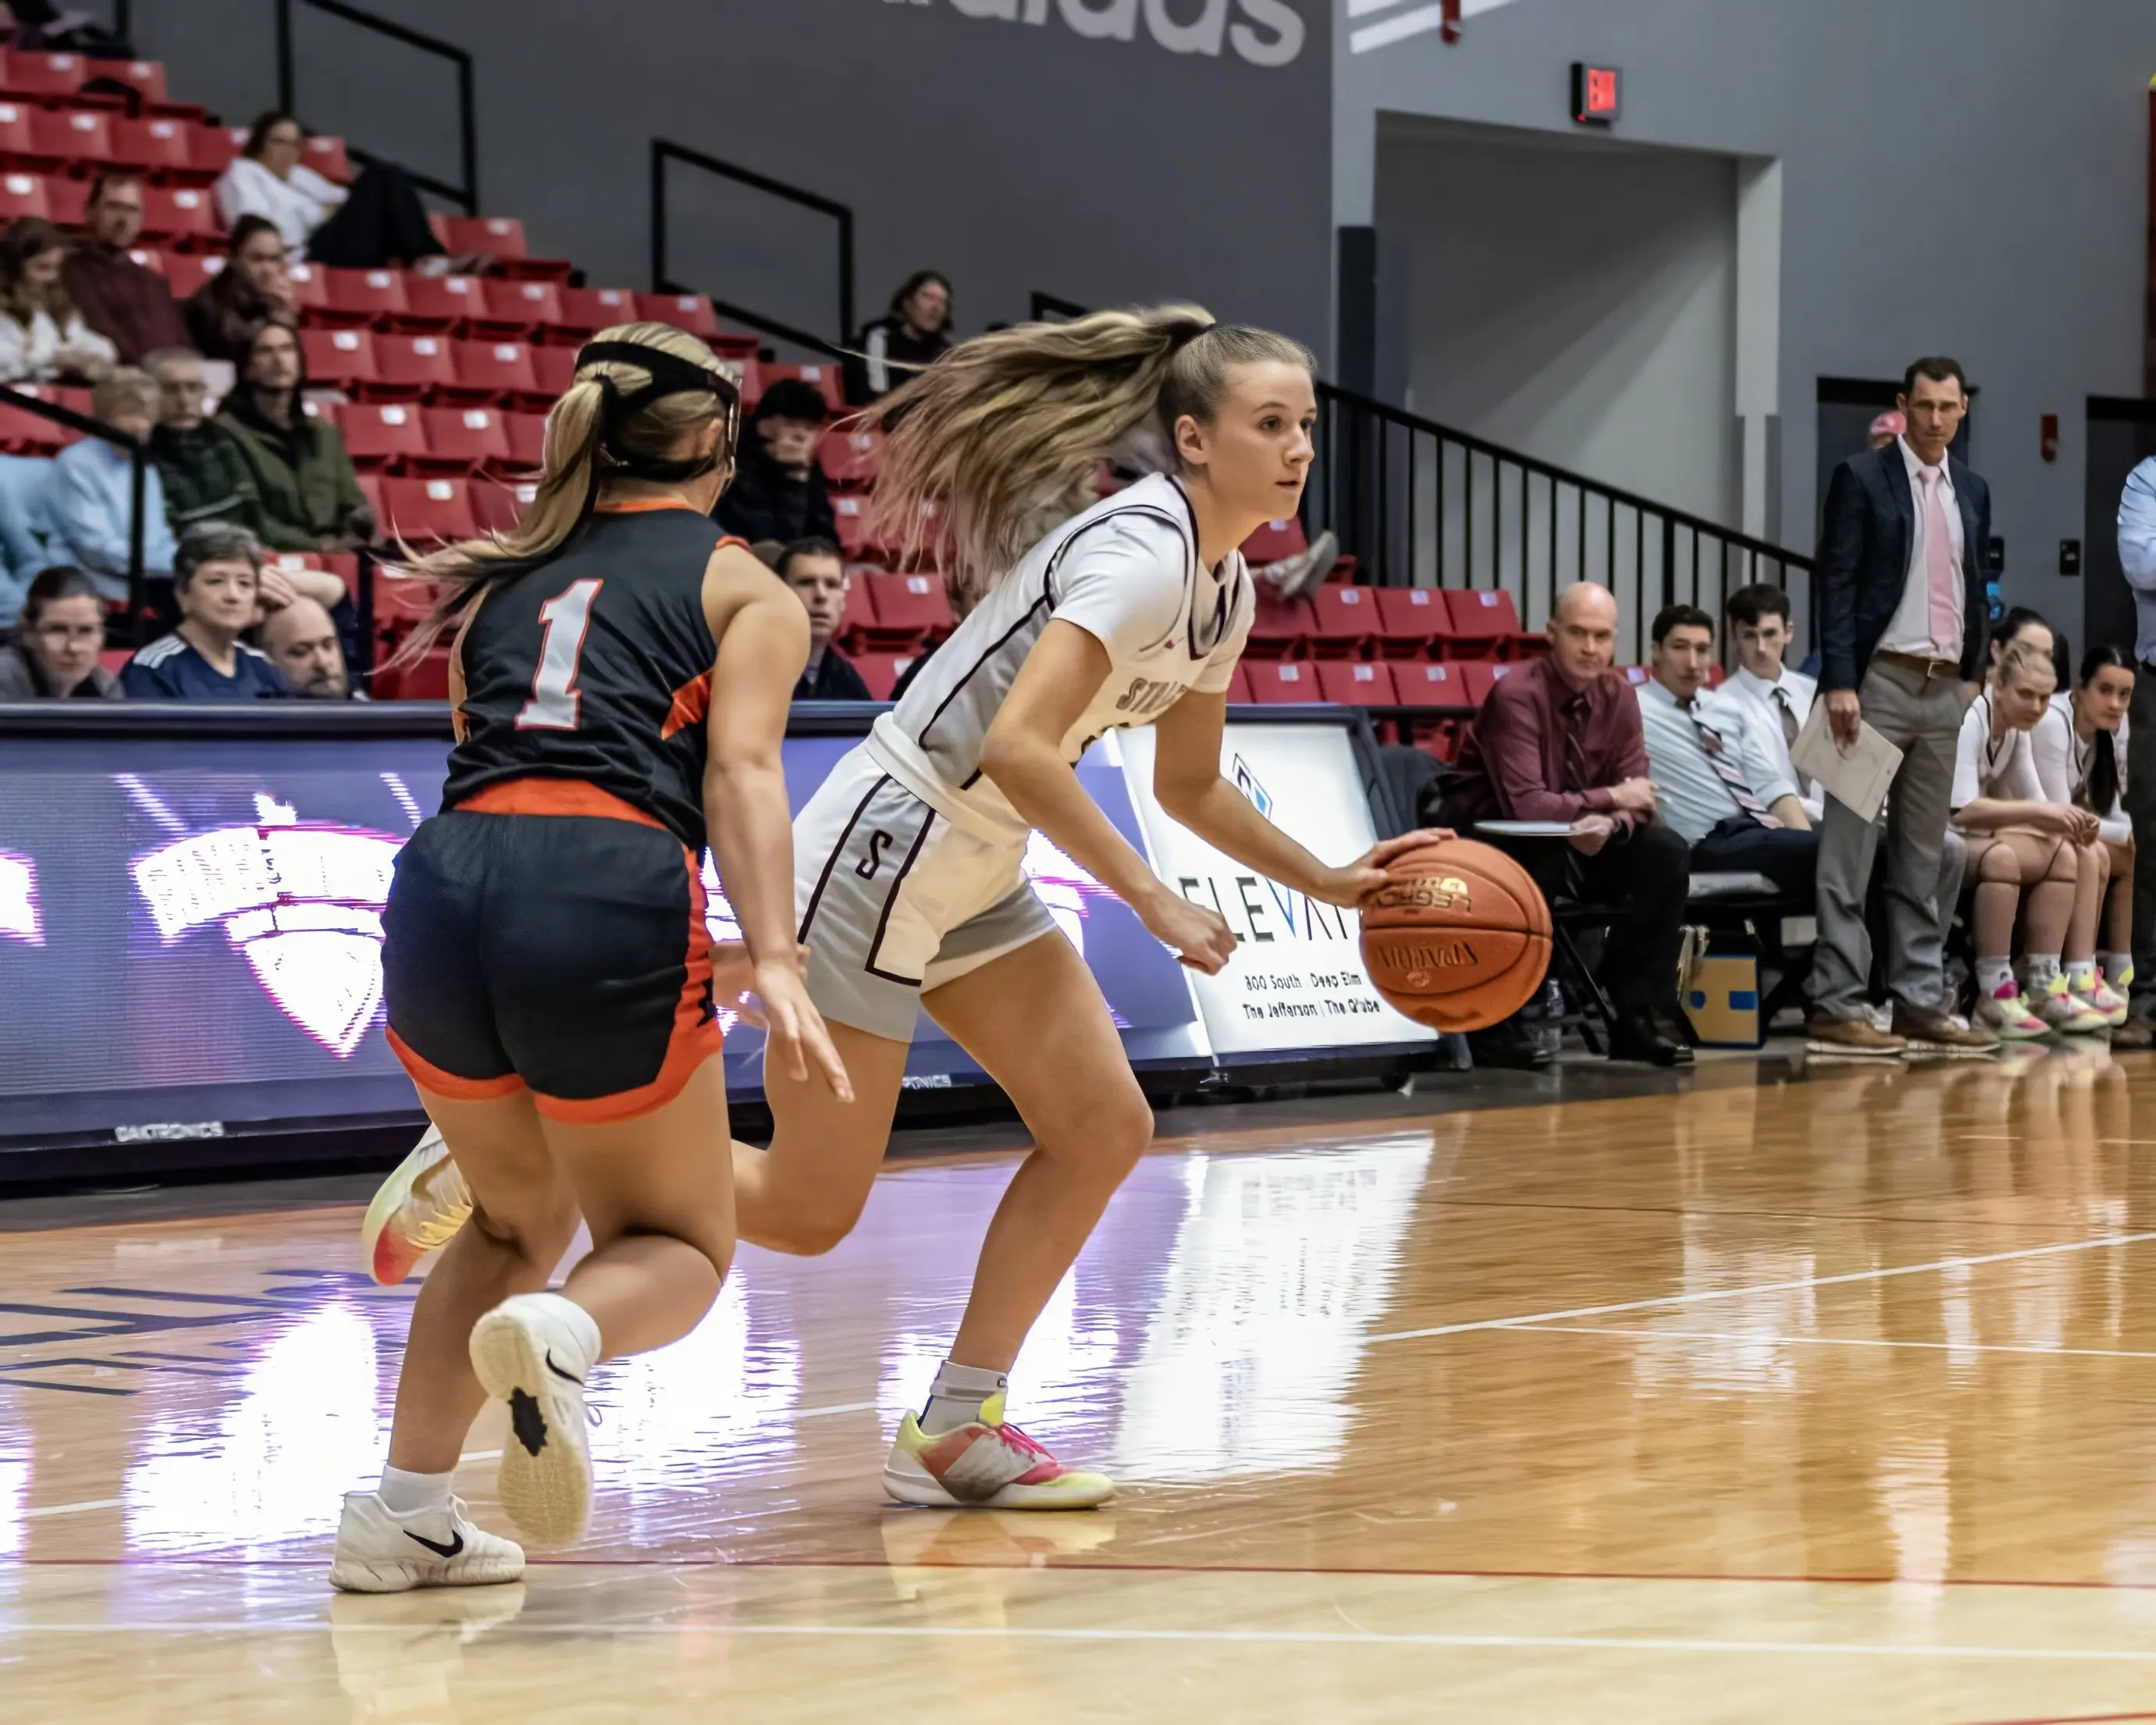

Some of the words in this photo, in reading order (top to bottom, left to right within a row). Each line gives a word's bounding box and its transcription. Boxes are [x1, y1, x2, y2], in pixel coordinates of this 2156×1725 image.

[514, 578, 604, 731] 1
[1270, 974, 1302, 989] South
[1310, 973, 1339, 988] Deep
[1242, 1003, 1264, 1019] The
[1267, 1001, 1318, 1018] Jefferson
[1324, 999, 1346, 1015] The
